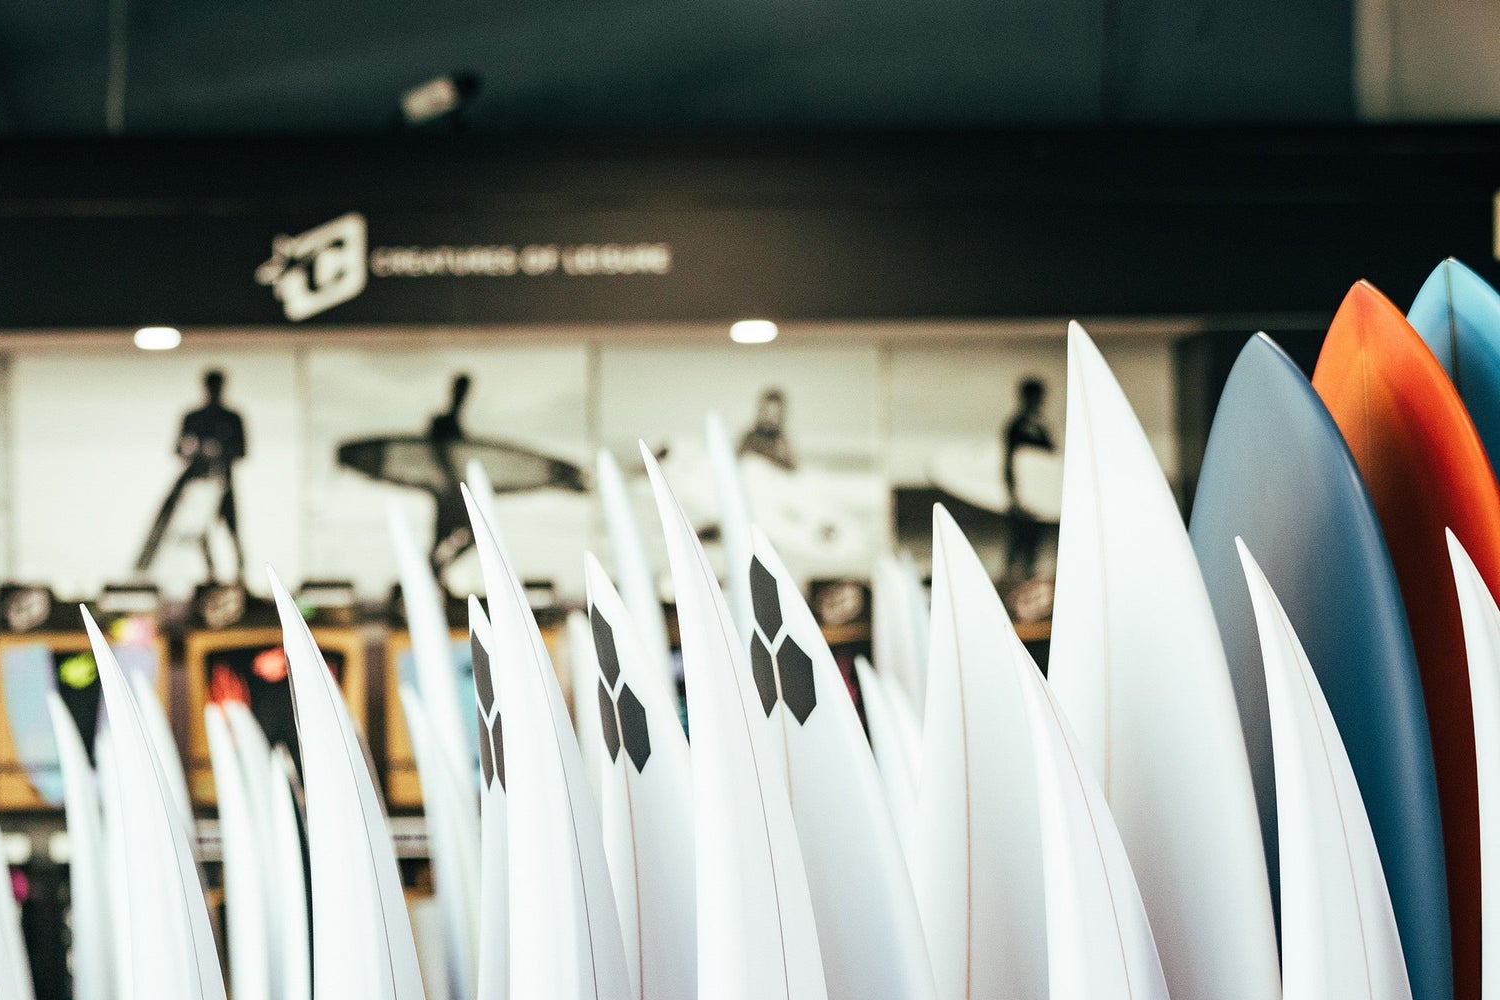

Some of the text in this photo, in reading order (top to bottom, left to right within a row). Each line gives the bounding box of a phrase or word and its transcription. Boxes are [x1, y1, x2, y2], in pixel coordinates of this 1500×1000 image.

[372, 243, 671, 276] CREATURES OF LEISURE
